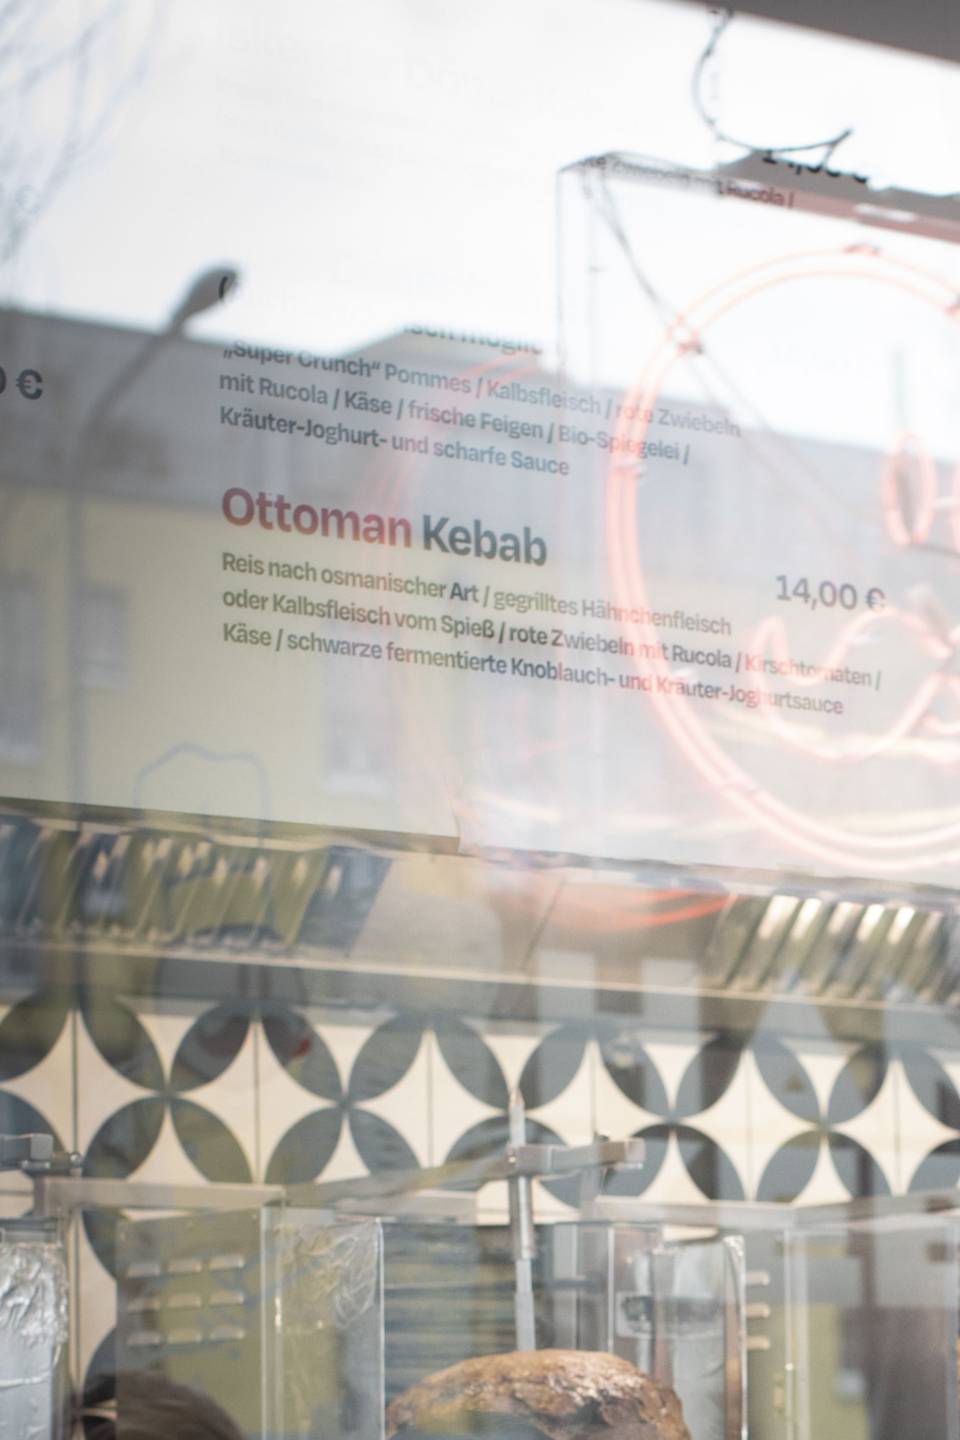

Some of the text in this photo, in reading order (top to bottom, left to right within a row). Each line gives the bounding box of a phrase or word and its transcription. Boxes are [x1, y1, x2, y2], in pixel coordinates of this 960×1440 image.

[219, 373, 254, 396] mit
[259, 377, 329, 406] Rucola
[345, 389, 393, 416] Käse
[408, 399, 476, 430] frische
[480, 412, 544, 447] Feigen
[558, 424, 681, 464] Bio-Spiegelei
[385, 364, 471, 395] Pommes
[486, 380, 601, 415] Kalbsfleisch
[658, 408, 742, 438] Zwiebeln
[219, 405, 570, 477] Kräuter-Joghurt- und scharfe Sauce
[222, 486, 548, 567] Ottoman Kebab
[222, 551, 265, 577] Reis
[268, 557, 317, 583] nach
[321, 566, 448, 599] osmanischer
[450, 581, 480, 603] Art
[493, 590, 579, 617] gegrilltes
[581, 598, 732, 637] Hähnchenfleisch
[222, 589, 267, 612] oder
[273, 593, 391, 627] Kalbsfleisch
[394, 610, 437, 633] vom
[440, 615, 496, 641] Spieß
[509, 626, 549, 648] rote
[551, 628, 635, 659] Zwiebeln
[672, 644, 733, 670] Rucola
[775, 574, 858, 612] 14,00
[222, 623, 272, 648] Käse
[287, 631, 382, 660] schwarze
[386, 640, 507, 675] fermentierte
[511, 658, 616, 689] Knoblauch-
